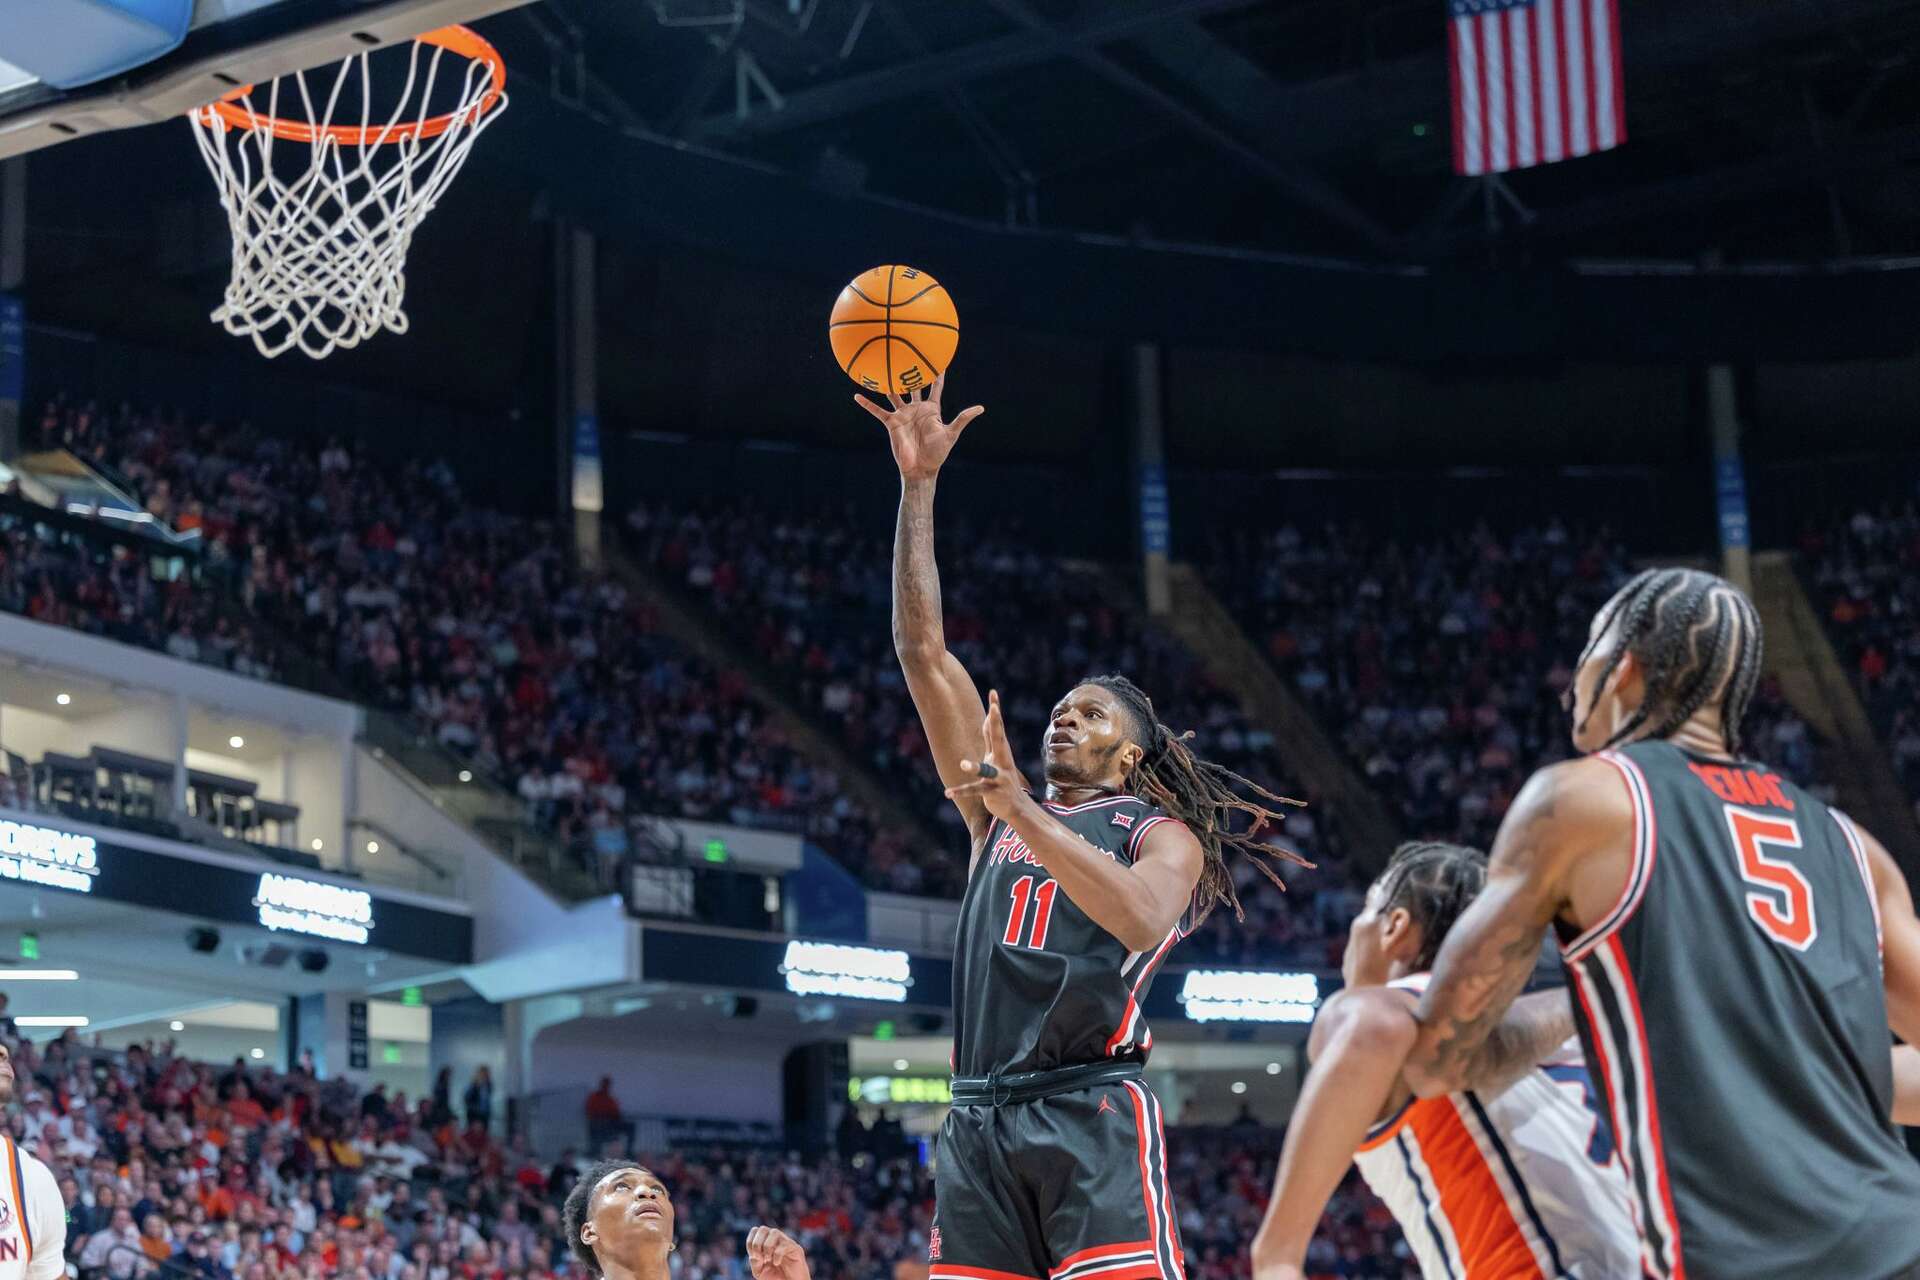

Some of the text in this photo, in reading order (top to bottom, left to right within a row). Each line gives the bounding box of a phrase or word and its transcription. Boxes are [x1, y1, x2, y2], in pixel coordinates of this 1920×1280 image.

[0, 820, 97, 870] DREWS
[1723, 803, 1818, 953] 5
[1002, 875, 1058, 950] 11
